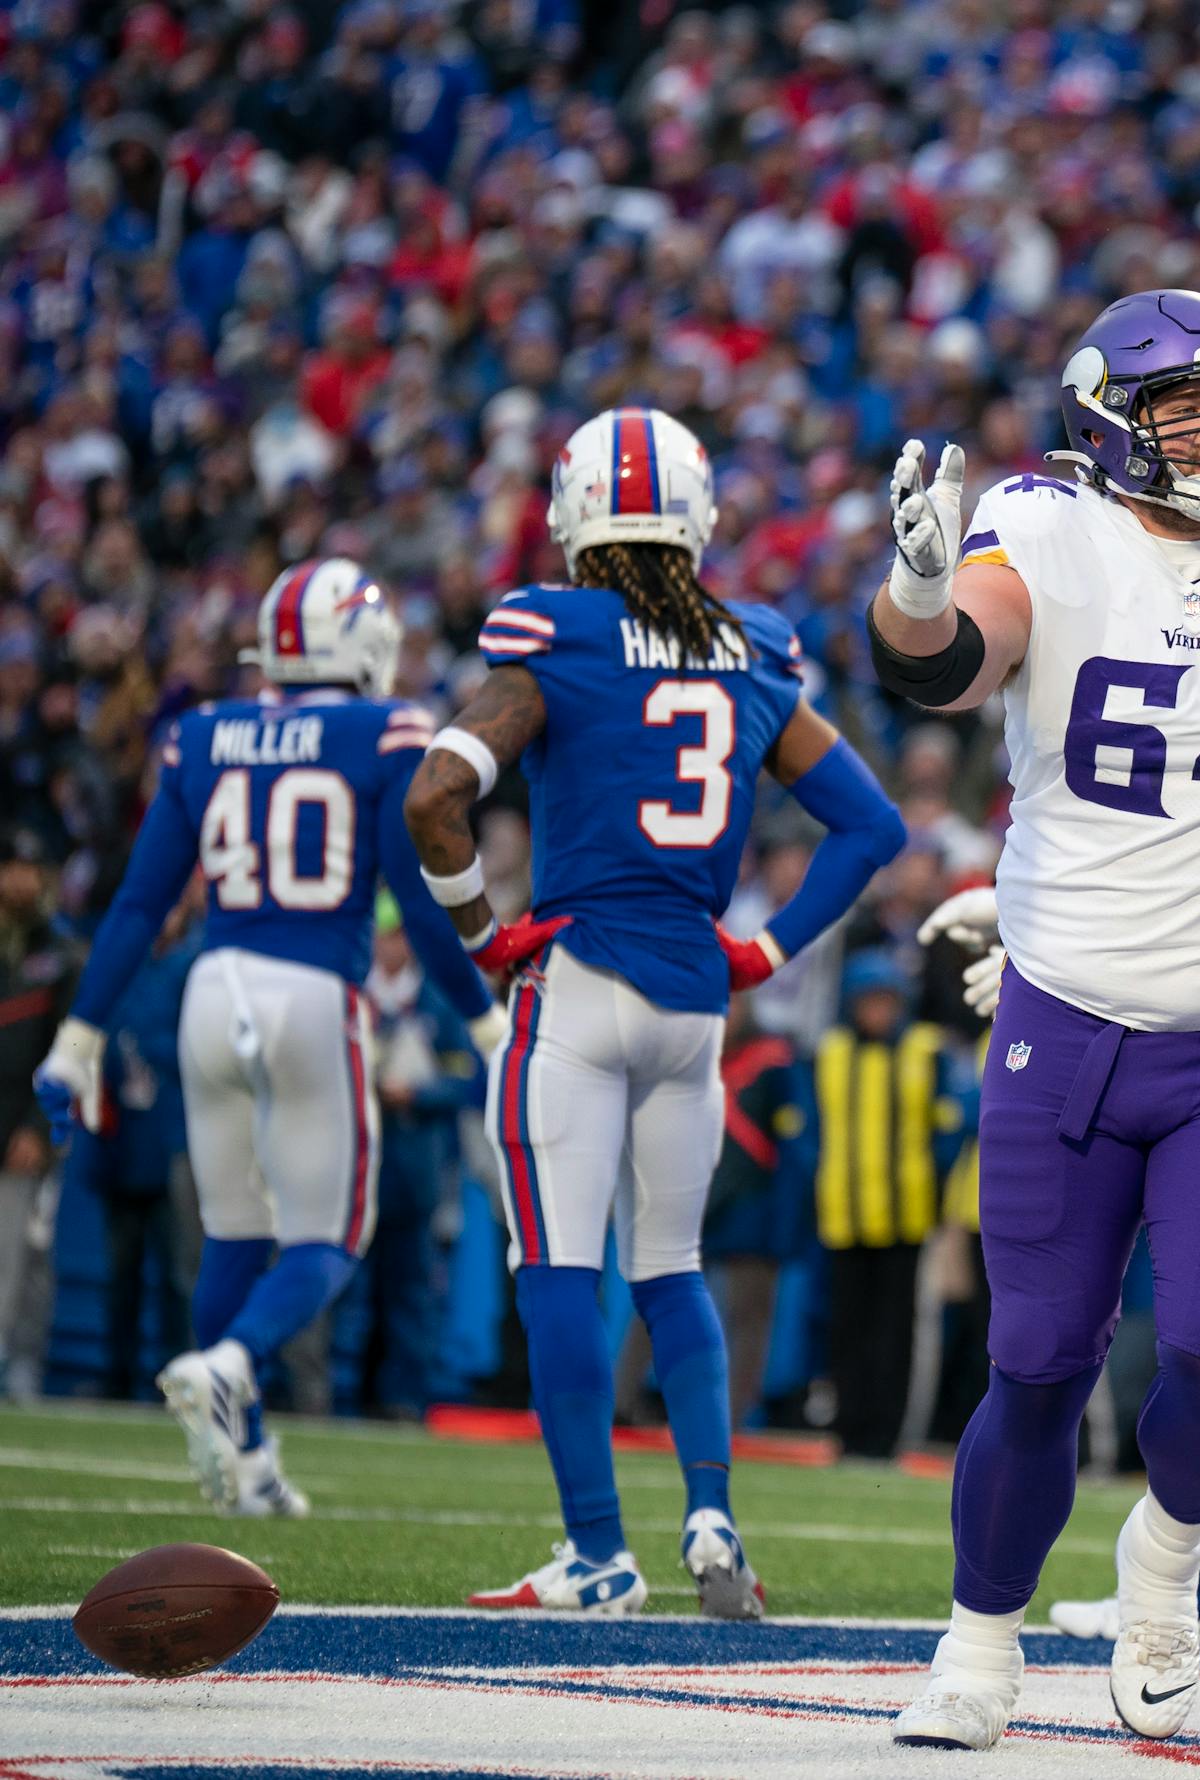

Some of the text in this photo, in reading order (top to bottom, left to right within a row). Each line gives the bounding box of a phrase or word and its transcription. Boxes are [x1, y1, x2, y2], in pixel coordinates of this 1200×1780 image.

[619, 617, 749, 672] HAIN
[210, 714, 325, 767] MILLER
[637, 678, 736, 849] 3
[199, 766, 357, 912] 40
